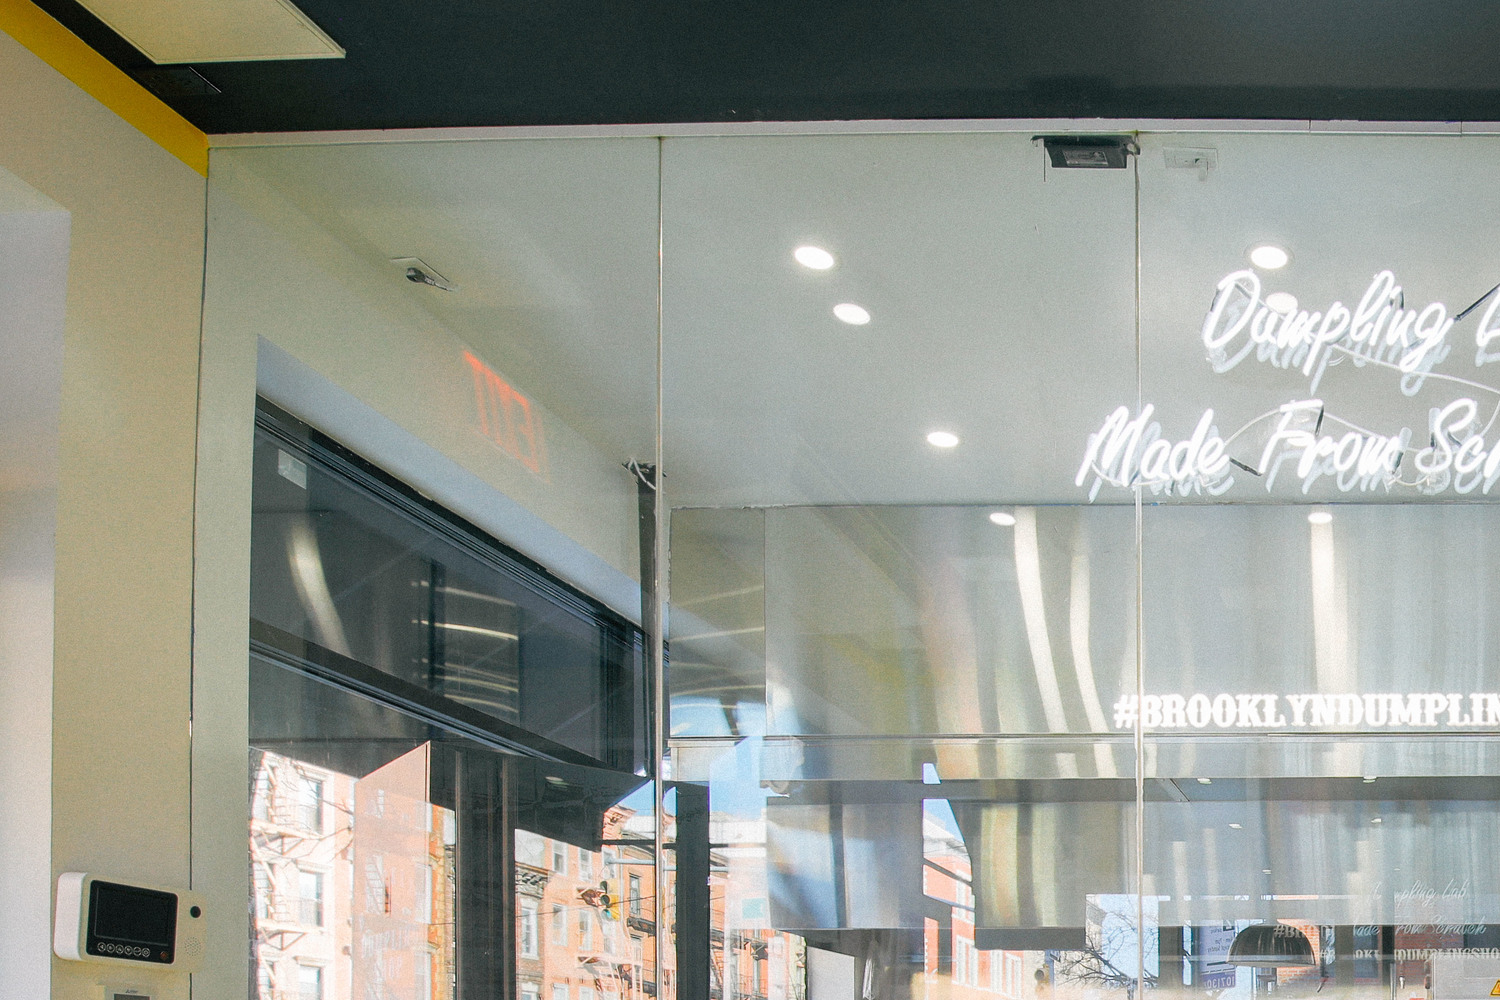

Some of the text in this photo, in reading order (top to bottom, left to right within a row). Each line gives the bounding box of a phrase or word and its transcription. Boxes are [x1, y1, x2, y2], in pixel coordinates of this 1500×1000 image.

[1202, 269, 1457, 375] Dumpling
[1075, 404, 1230, 487] Made
[1260, 399, 1400, 479] From
